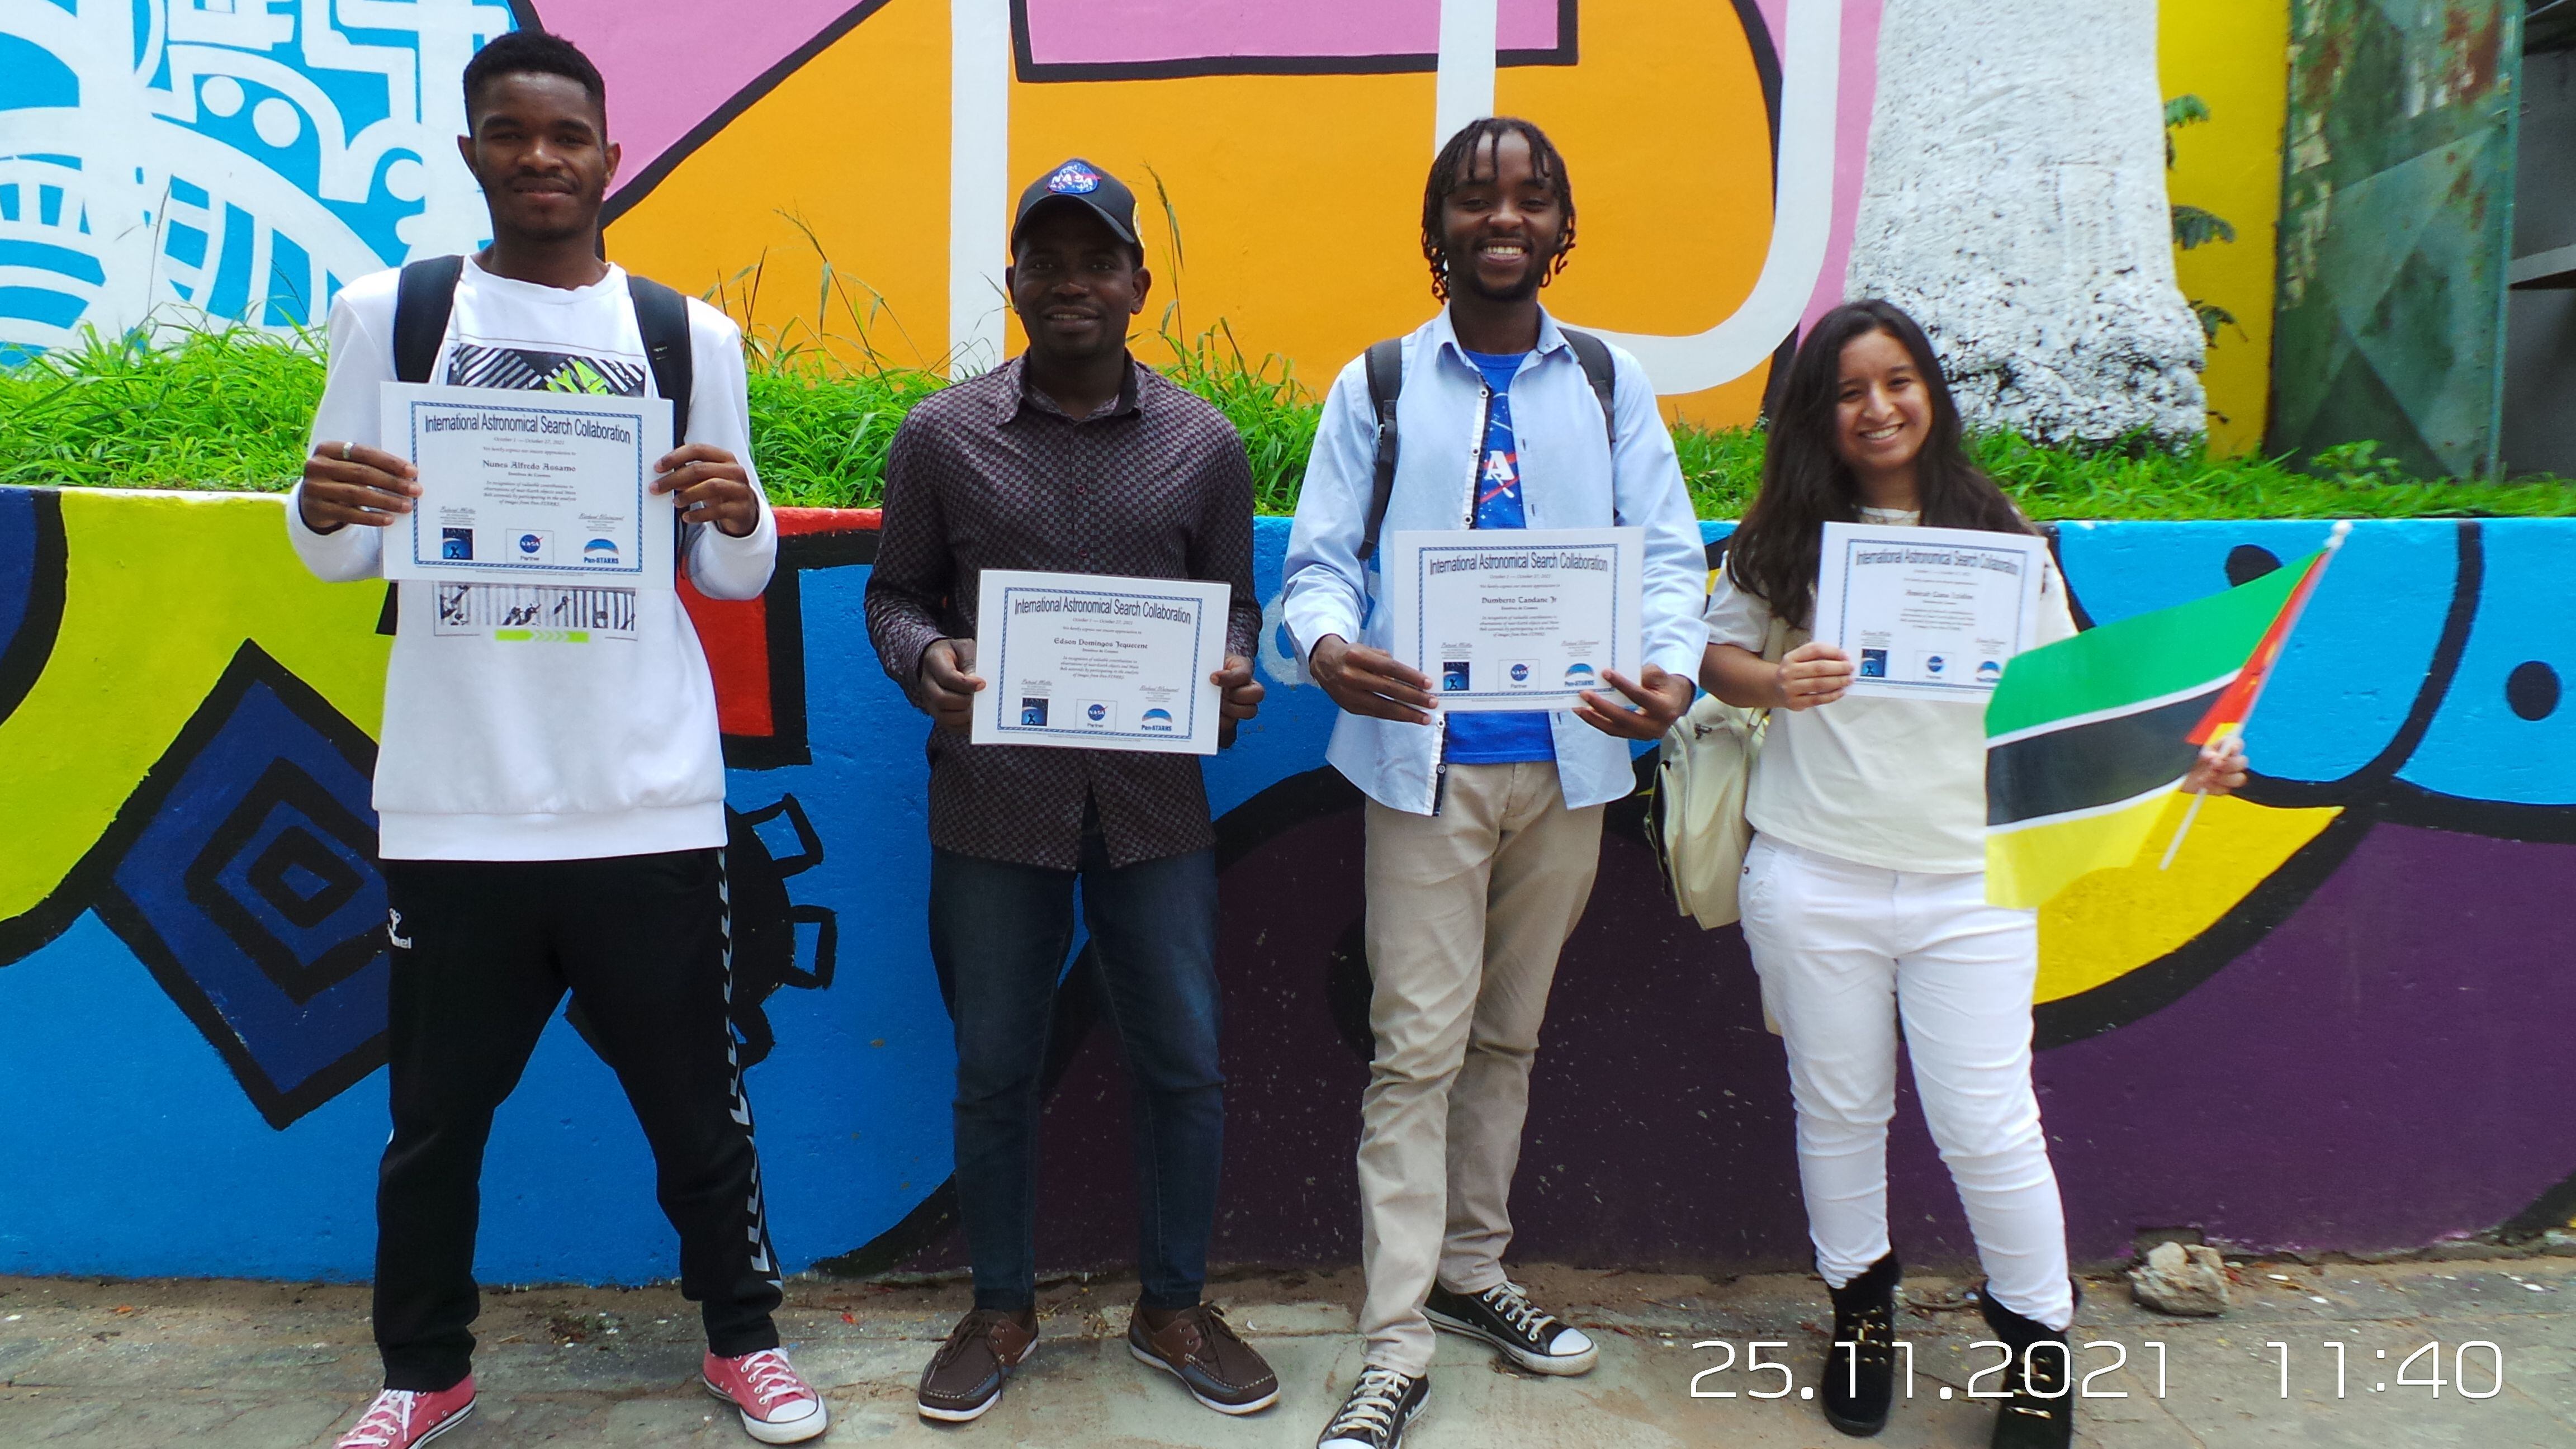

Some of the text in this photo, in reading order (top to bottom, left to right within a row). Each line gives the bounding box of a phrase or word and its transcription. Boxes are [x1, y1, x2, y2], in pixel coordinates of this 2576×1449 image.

[1051, 173, 1093, 190] NASA
[425, 412, 631, 444] International Astronomical Search Collaboration
[482, 460, 508, 468] Nunes
[510, 461, 539, 470] Alfredo
[584, 556, 619, 565] Pan-STARRS
[1430, 552, 1608, 575] International Astronomical Search Collaboration
[1015, 596, 1191, 625] International Astronomical Search Collaboration
[1078, 638, 1113, 647] Domingos
